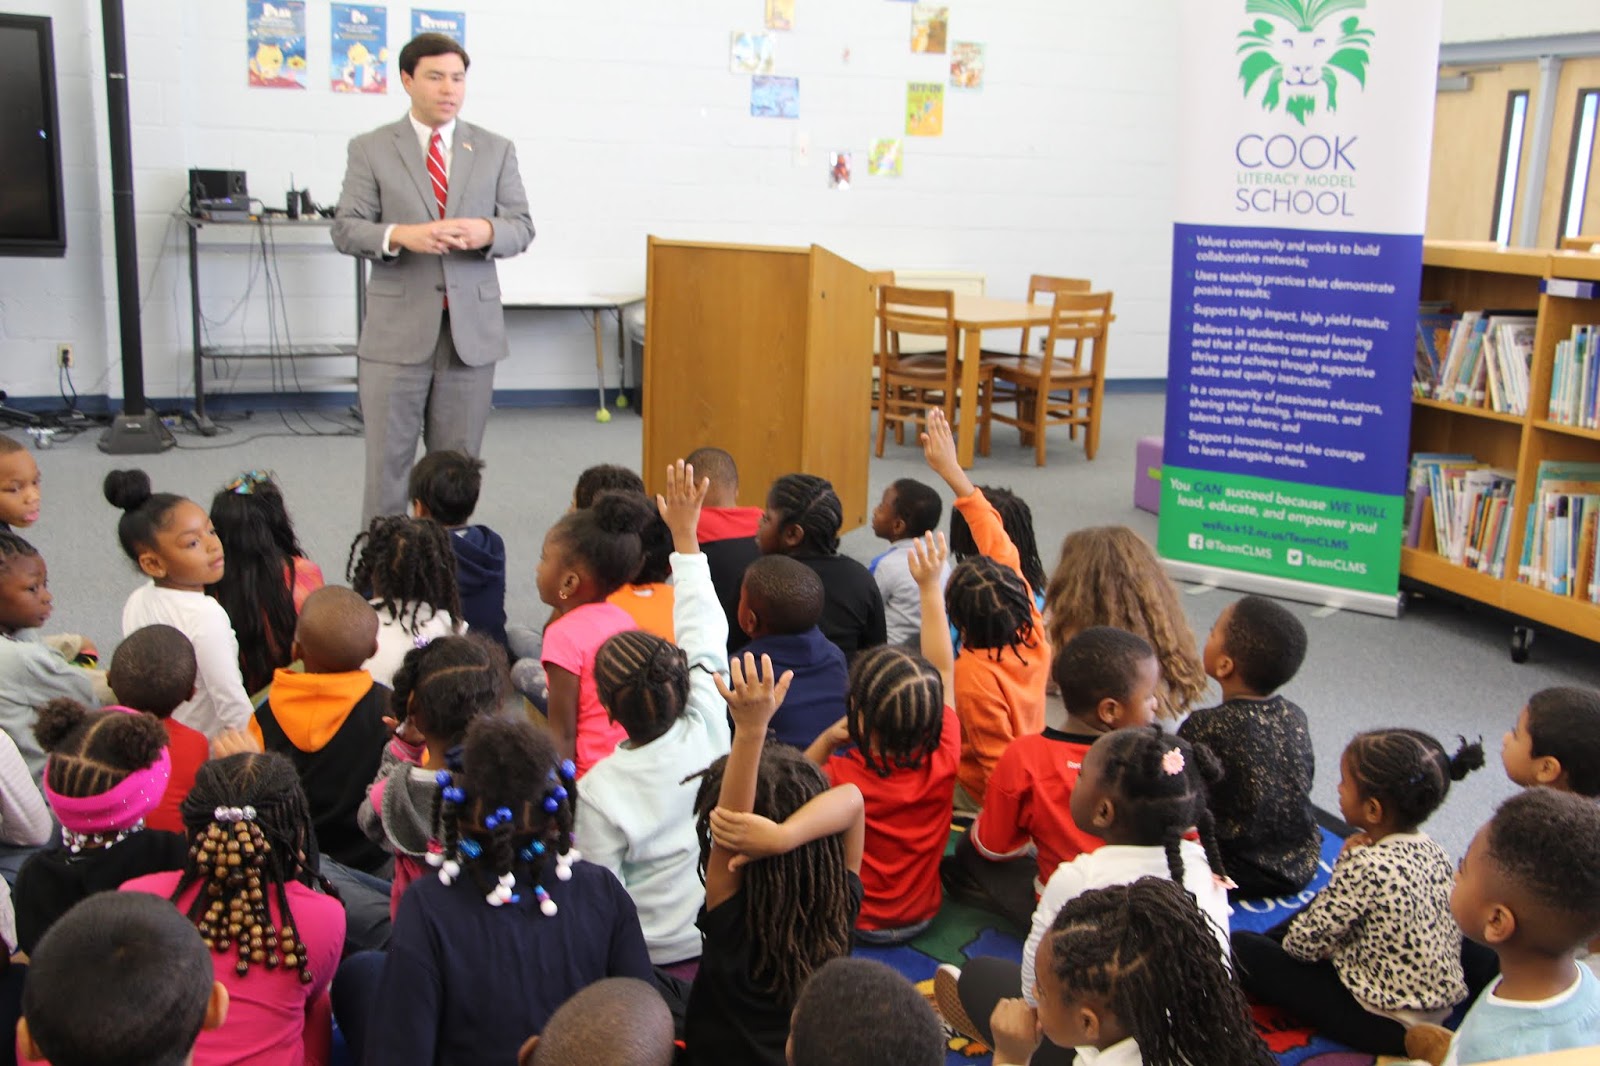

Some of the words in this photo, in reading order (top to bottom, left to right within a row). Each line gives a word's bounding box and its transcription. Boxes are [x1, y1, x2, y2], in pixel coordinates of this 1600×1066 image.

[1236, 134, 1357, 171] COOK
[1237, 171, 1299, 185] LITERACY
[1306, 174, 1356, 188] MODEL
[1236, 188, 1355, 216] SCHOOL
[1196, 236, 1227, 248] Values
[1230, 239, 1284, 253] community
[1287, 240, 1305, 252] and
[1307, 244, 1337, 254] works
[1339, 244, 1352, 255] to
[1353, 244, 1380, 256] build
[1196, 251, 1260, 264] collaborative
[1194, 286, 1232, 298] positive
[1195, 270, 1217, 281] Uses
[1220, 271, 1262, 286] teaching
[1308, 277, 1328, 289] that
[1330, 278, 1395, 294] demonstrate
[1194, 303, 1238, 318] Supports
[1240, 306, 1262, 319] high
[1301, 310, 1323, 325] high
[1325, 314, 1350, 327] yield
[1193, 323, 1232, 336] Believes
[1235, 325, 1244, 336] in
[1331, 330, 1372, 349] learning
[1192, 337, 1210, 348] and
[1213, 339, 1232, 350] that
[1235, 340, 1246, 351] all
[1249, 341, 1289, 355] students
[1291, 346, 1308, 356] can
[1310, 345, 1329, 358] and
[1332, 348, 1366, 362] should
[1191, 366, 1220, 378] adults
[1222, 368, 1241, 379] and
[1243, 369, 1276, 384] quality
[1192, 351, 1219, 363] thrive
[1221, 354, 1241, 365] and
[1243, 354, 1278, 368] achieve
[1281, 358, 1319, 374] through
[1321, 362, 1375, 378] supportive
[1191, 384, 1198, 394] Is
[1200, 387, 1207, 395] a
[1209, 385, 1262, 400] community
[1265, 390, 1275, 400] of
[1277, 394, 1328, 408] passionate
[1190, 399, 1224, 412] sharing
[1227, 400, 1250, 411] their
[1342, 414, 1362, 426] and
[1190, 412, 1221, 423] talents
[1224, 415, 1244, 426] with
[1282, 422, 1300, 433] and
[1188, 429, 1232, 444] Supports
[1234, 435, 1282, 449] innovation
[1284, 441, 1303, 453] and
[1305, 443, 1322, 455] the
[1324, 447, 1365, 462] courage
[1188, 444, 1199, 454] to
[1201, 445, 1225, 457] learn
[1227, 448, 1272, 464] alongside
[1170, 478, 1190, 491] You
[1194, 481, 1222, 495] CAN
[1225, 487, 1273, 502] succeed
[1276, 492, 1326, 510] because
[1330, 500, 1350, 513] WE
[1356, 503, 1386, 518] WILL
[1177, 495, 1205, 509] lead,
[1209, 499, 1259, 517] educate,
[1262, 506, 1285, 520] and
[1288, 510, 1347, 529] empower
[1349, 520, 1377, 534] you!
[1205, 539, 1272, 559] @TeamCLMS
[1306, 555, 1367, 574] TeamCLMS
